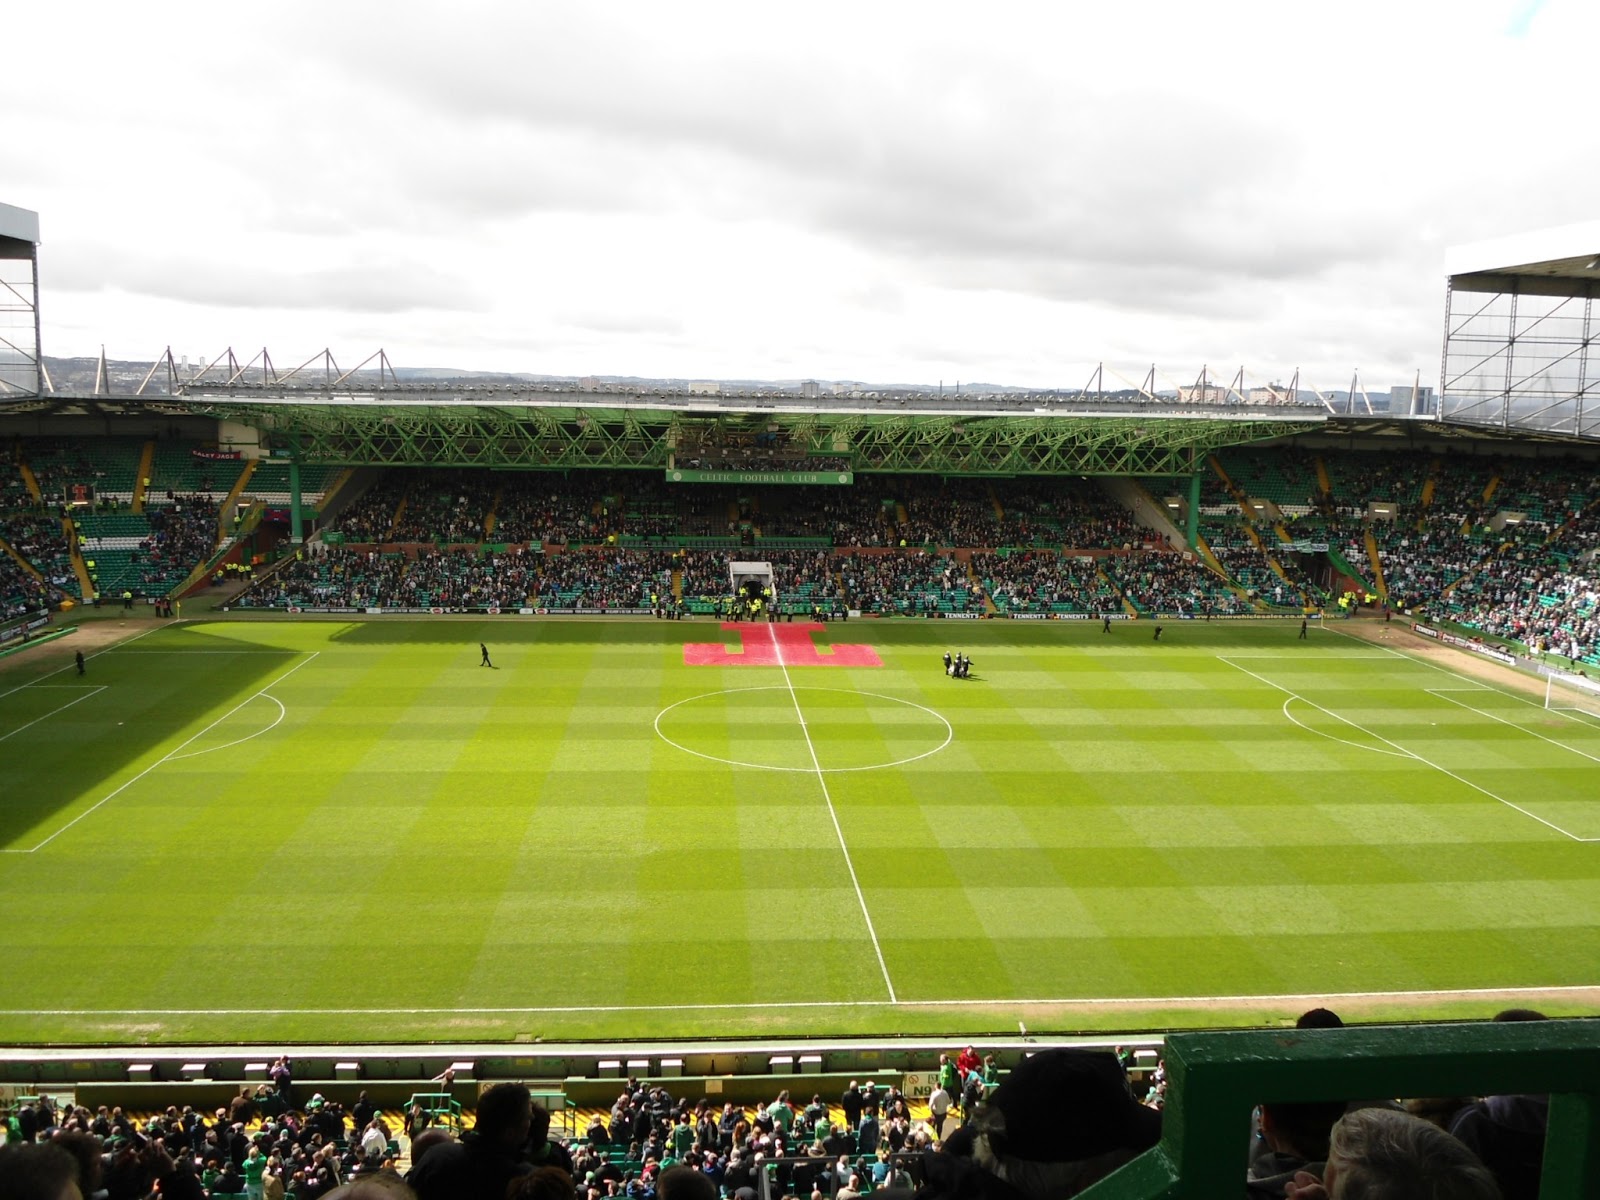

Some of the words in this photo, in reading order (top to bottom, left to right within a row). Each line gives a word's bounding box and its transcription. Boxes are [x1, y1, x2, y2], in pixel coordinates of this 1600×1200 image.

[699, 473, 732, 482] CELTIC
[739, 473, 785, 482] FOOTBALL
[792, 474, 817, 483] CLUB
